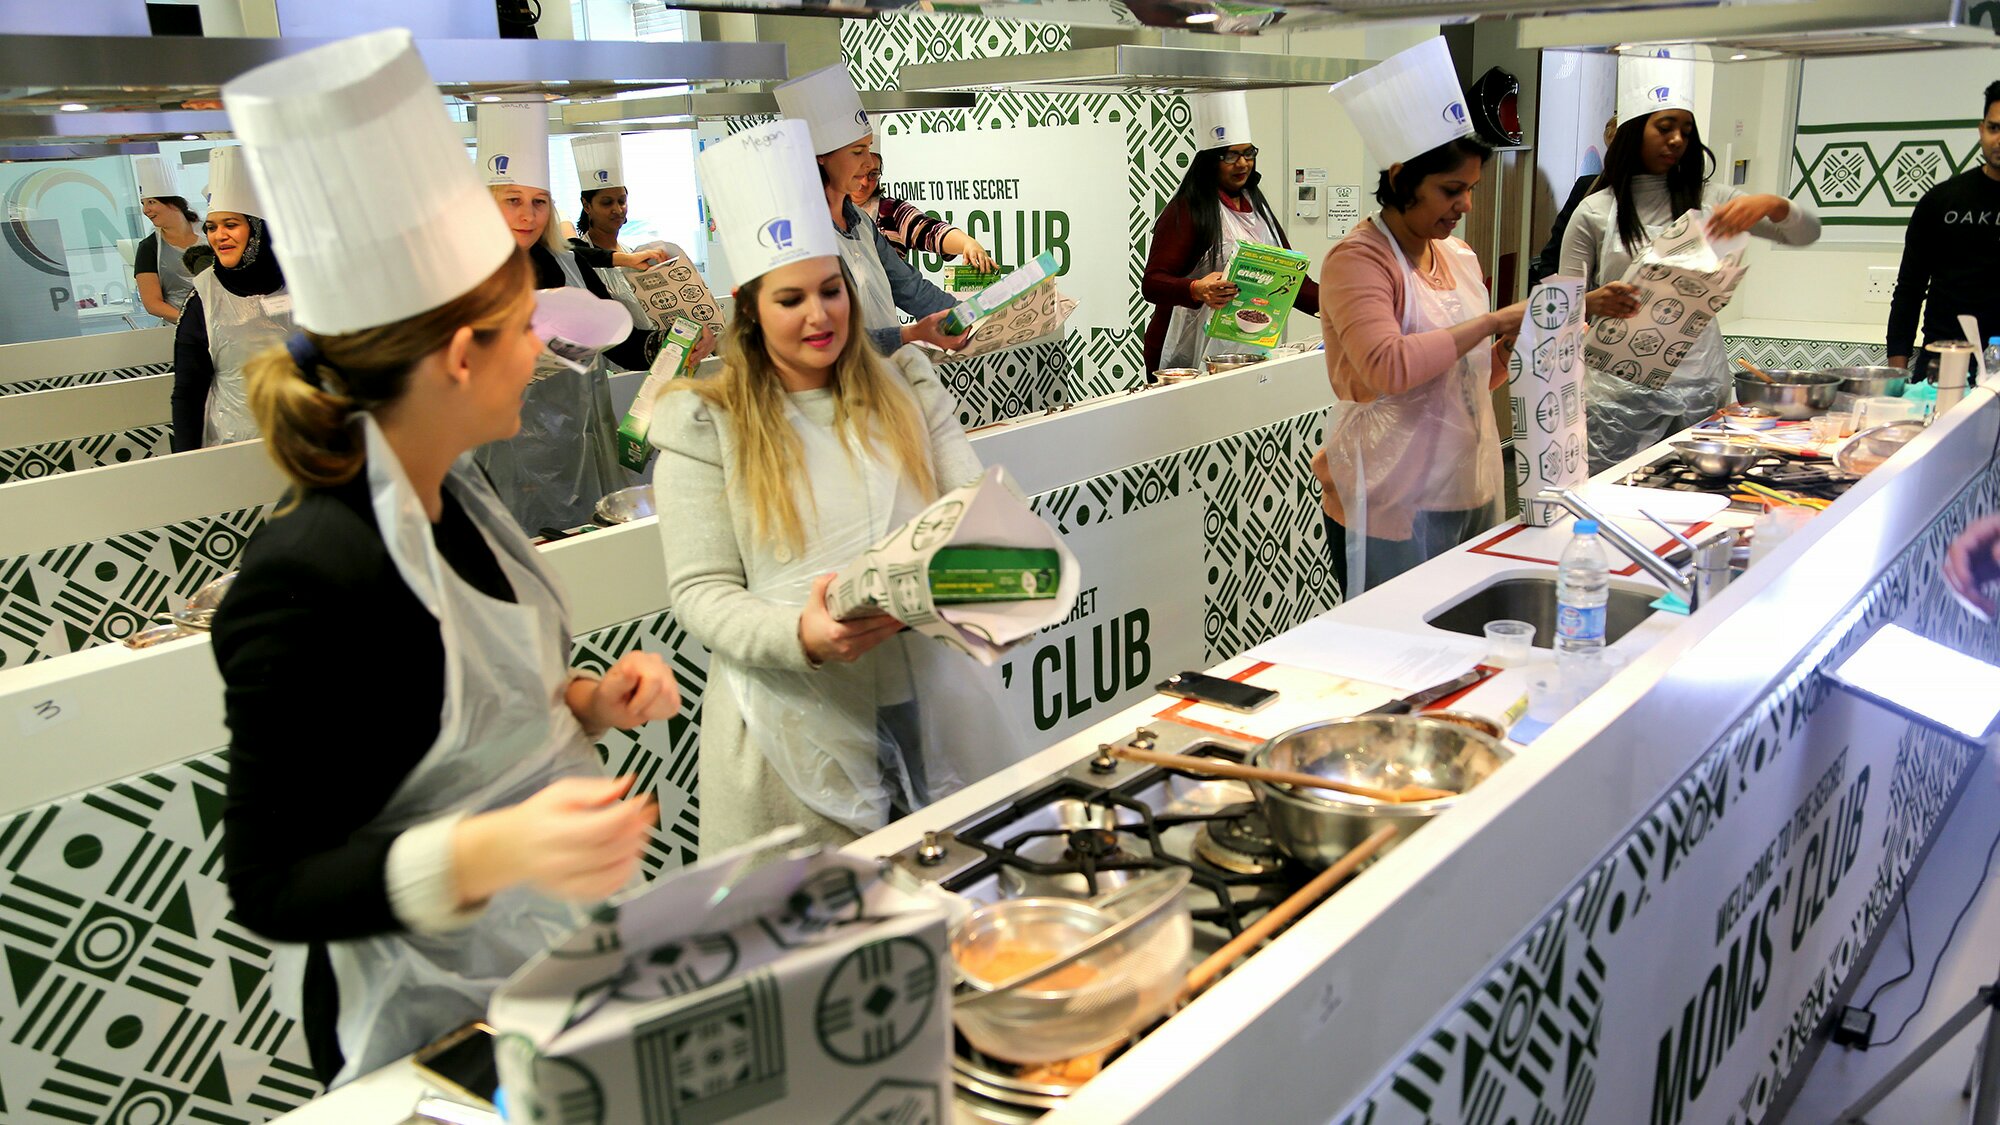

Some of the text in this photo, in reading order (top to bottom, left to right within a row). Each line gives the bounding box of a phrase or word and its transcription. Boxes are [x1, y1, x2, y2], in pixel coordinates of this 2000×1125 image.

[741, 130, 785, 152] Megan
[928, 180, 944, 201] TO
[946, 179, 969, 201] THE
[972, 178, 1020, 200] SECRET
[967, 209, 1071, 277] CLUB
[1237, 269, 1274, 286] energy
[1032, 607, 1151, 731] CLUB
[1715, 838, 1776, 947] WELCOME
[1776, 819, 1793, 867] TO
[1791, 764, 1871, 952] CLUB
